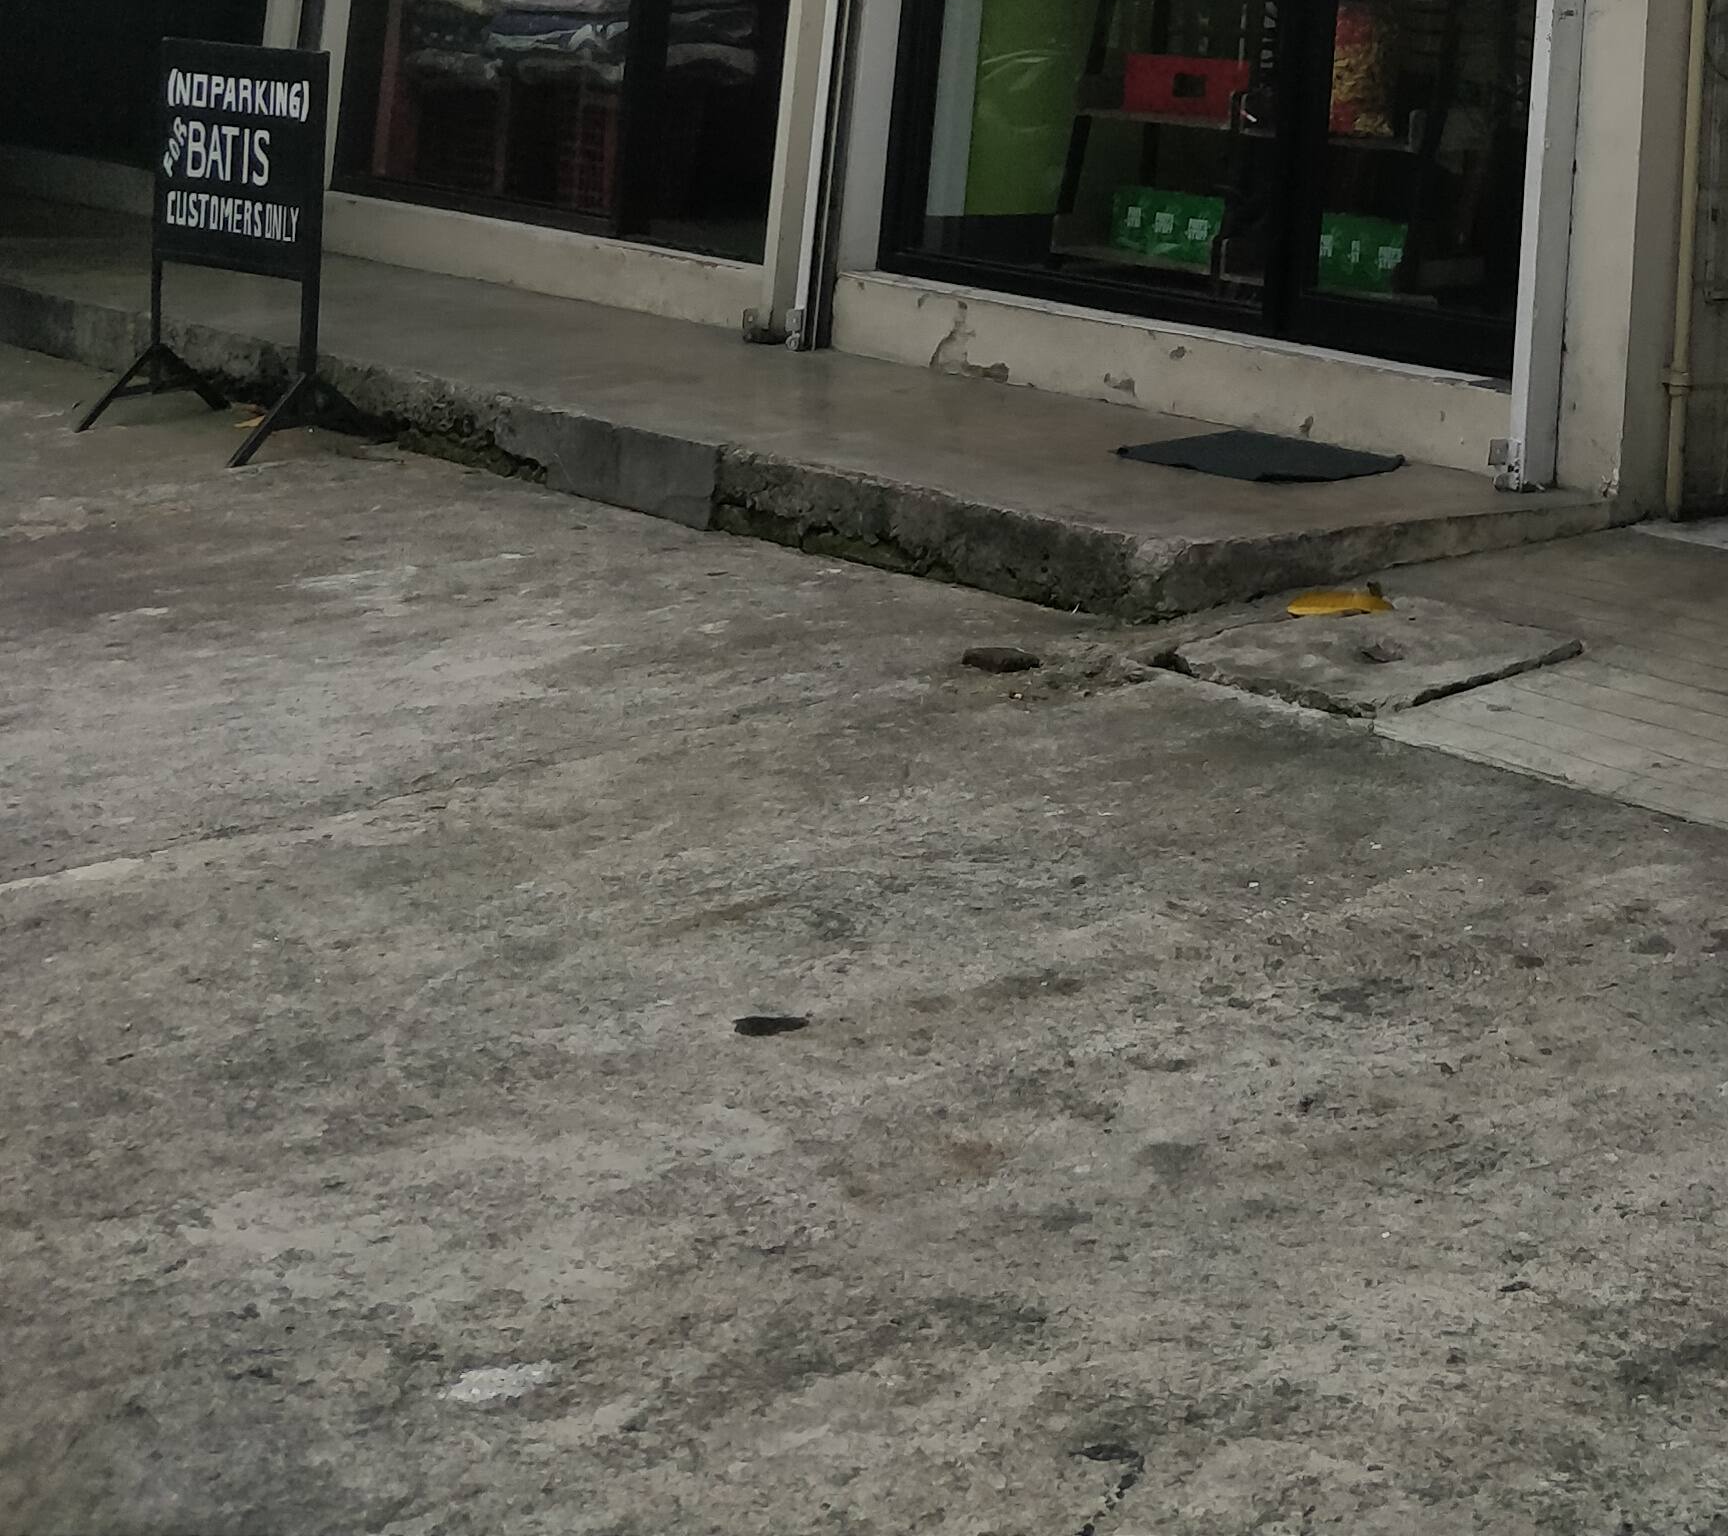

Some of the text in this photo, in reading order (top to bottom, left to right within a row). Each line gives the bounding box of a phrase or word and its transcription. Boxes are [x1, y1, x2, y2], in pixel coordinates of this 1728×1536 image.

[162, 116, 271, 187] FOR BATIS
[166, 190, 300, 243] CUSTOMERS ONLY
